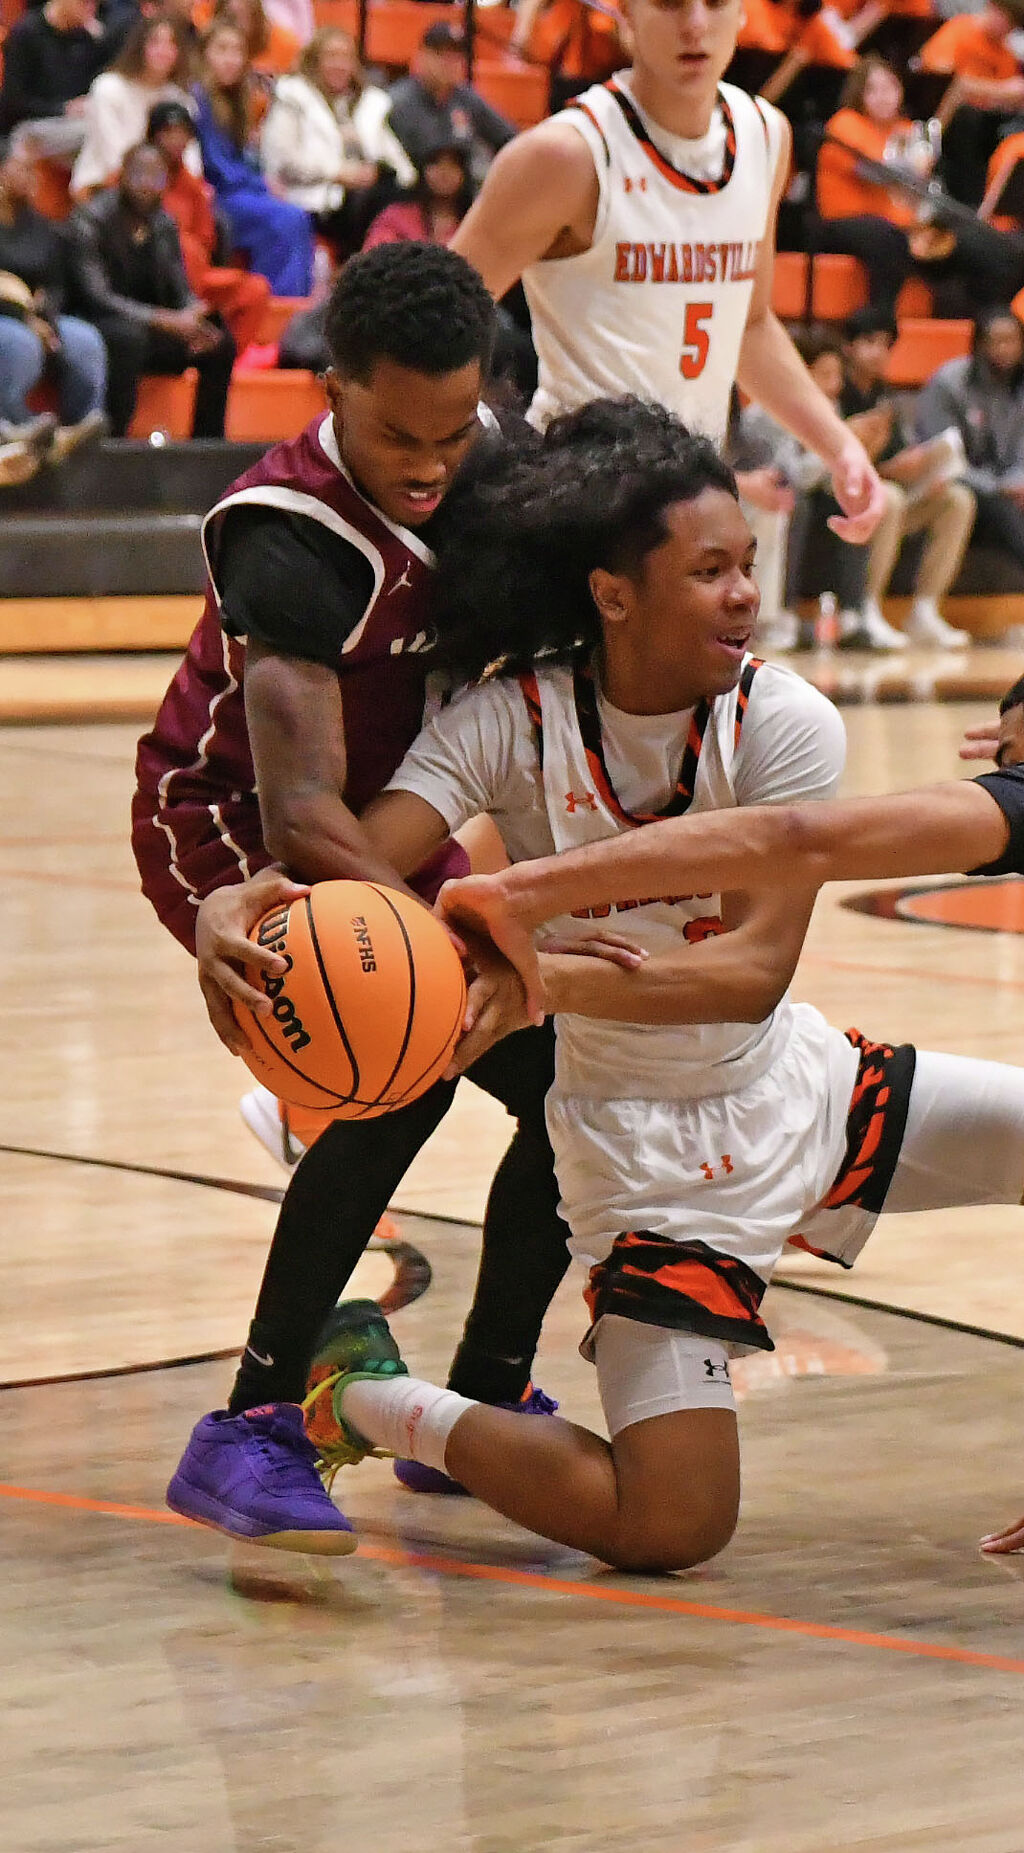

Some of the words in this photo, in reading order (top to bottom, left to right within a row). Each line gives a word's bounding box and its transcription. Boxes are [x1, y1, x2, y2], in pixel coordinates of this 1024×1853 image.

[615, 241, 757, 283] EDWARDSVILL
[679, 303, 713, 380] 5
[353, 927, 377, 973] NFHS
